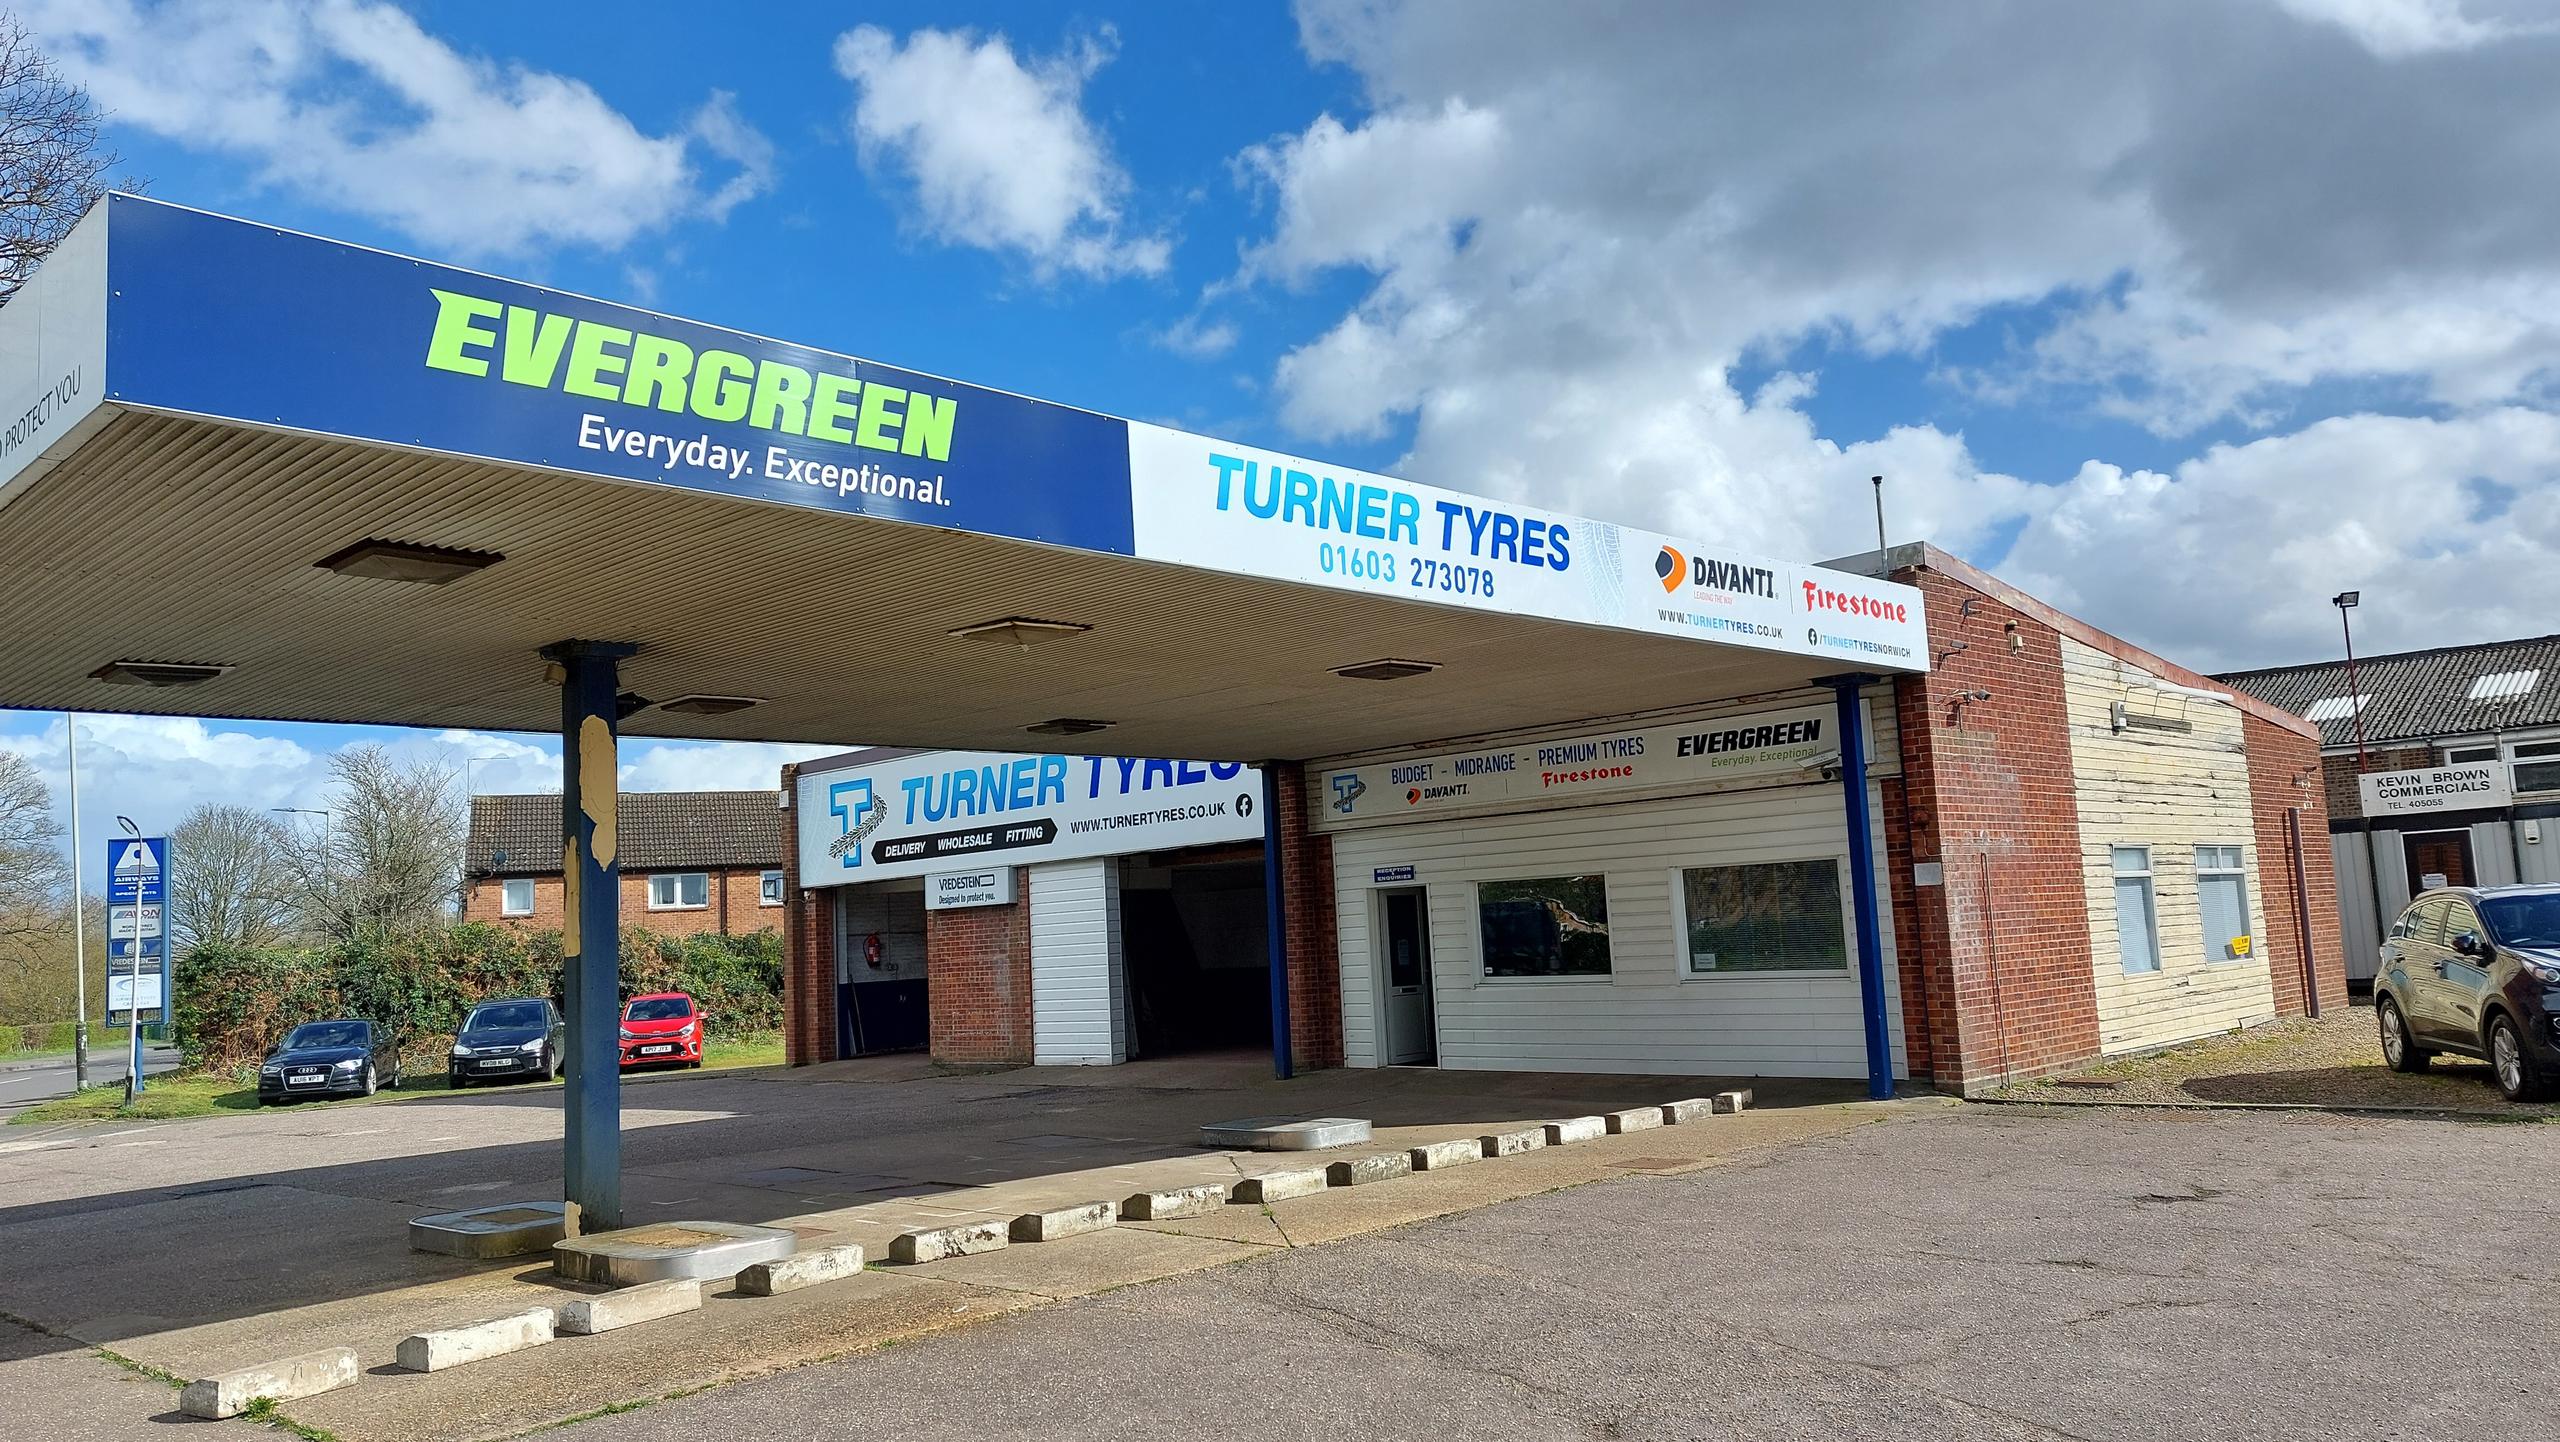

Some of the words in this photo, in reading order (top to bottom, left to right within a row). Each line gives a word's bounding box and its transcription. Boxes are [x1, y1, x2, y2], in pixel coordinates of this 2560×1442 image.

[425, 288, 957, 462] EVERGREEN
[5, 390, 53, 457] PROTECT
[55, 364, 81, 411] YOU
[578, 414, 753, 481] Everyday.
[765, 447, 951, 507] Exceptional.
[1208, 452, 1420, 546] TURNER
[1435, 500, 1570, 572] TYRES
[1319, 542, 1396, 583] 01603
[1410, 557, 1494, 598] 273078
[1692, 556, 1773, 599] DAVANTI
[1802, 580, 1907, 624] Firestone
[1657, 609, 1784, 639] WWW.TURNERTYRES.CO.UK
[1676, 719, 1822, 758] EVERGREEN
[1391, 763, 1434, 785] BUDGET
[1454, 753, 1516, 777] MIDRANGE
[1538, 742, 1598, 767] PREMIUM
[1601, 736, 1645, 759] TYRES
[1541, 764, 1634, 789] Firestone
[1711, 755, 1758, 769] Everyday.
[2376, 774, 2421, 787] KEVIN
[2432, 769, 2490, 783] BROWN
[901, 754, 1068, 825] TURNER
[2379, 781, 2490, 799] COMMERCIALS
[2409, 799, 2444, 808] 405055
[1070, 802, 1226, 835] WWW.TURNERTYRES.CO.UK
[885, 841, 927, 858] DELIVERY
[937, 833, 993, 851] WHOLESALE
[1006, 826, 1044, 842] FITTING
[939, 876, 981, 891] VREDESTEIN
[939, 894, 960, 905] Designed
[961, 894, 966, 902] to
[967, 892, 984, 904] protect
